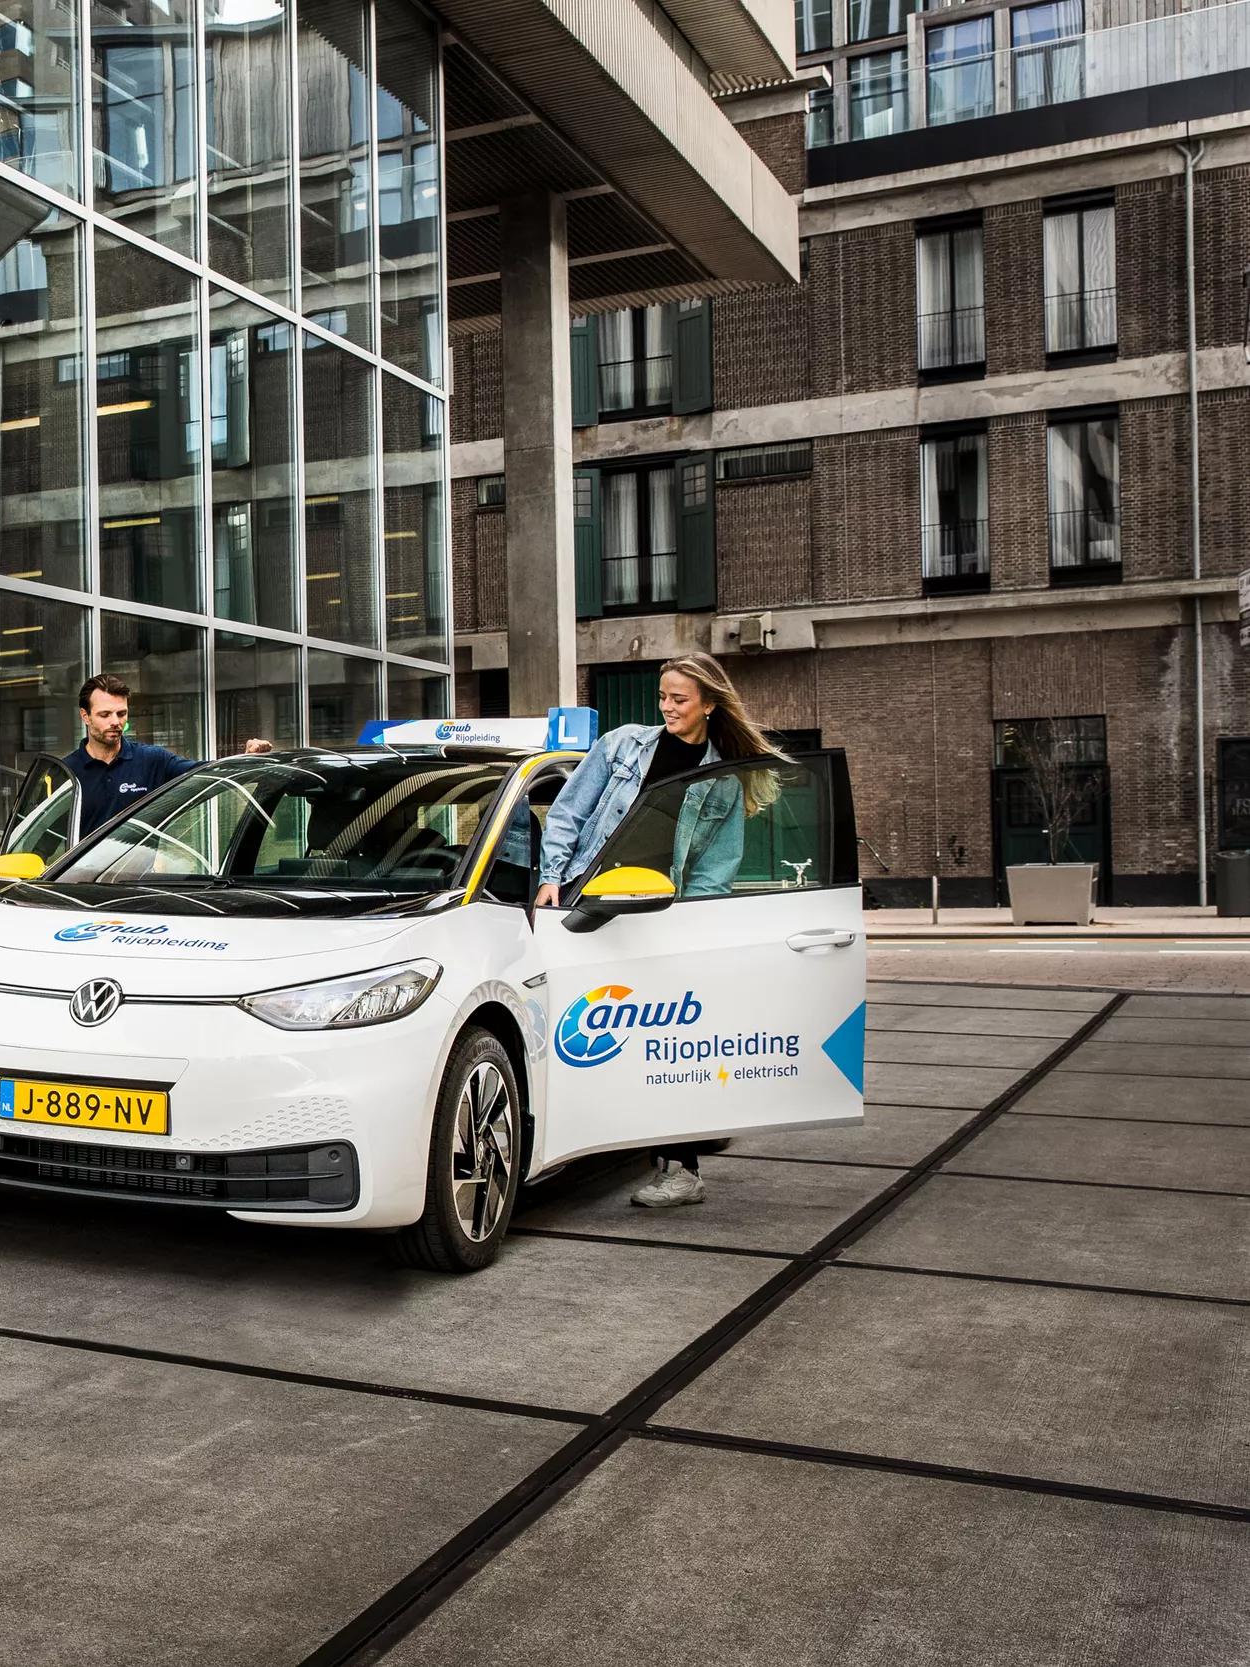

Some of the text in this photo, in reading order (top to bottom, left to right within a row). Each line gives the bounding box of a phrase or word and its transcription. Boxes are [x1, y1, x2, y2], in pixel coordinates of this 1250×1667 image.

[443, 724, 471, 732] anwb
[558, 715, 578, 744] L
[455, 733, 501, 743] Rijopleiding
[83, 924, 170, 935] anwb
[111, 935, 229, 951] Rijopleiding
[586, 991, 703, 1030] anwb
[645, 1032, 800, 1064] Rijopleiding
[646, 1065, 798, 1085] natuurlijk elektrisch
[2, 1103, 13, 1112] NL
[22, 1089, 153, 1125] J-889-NV
